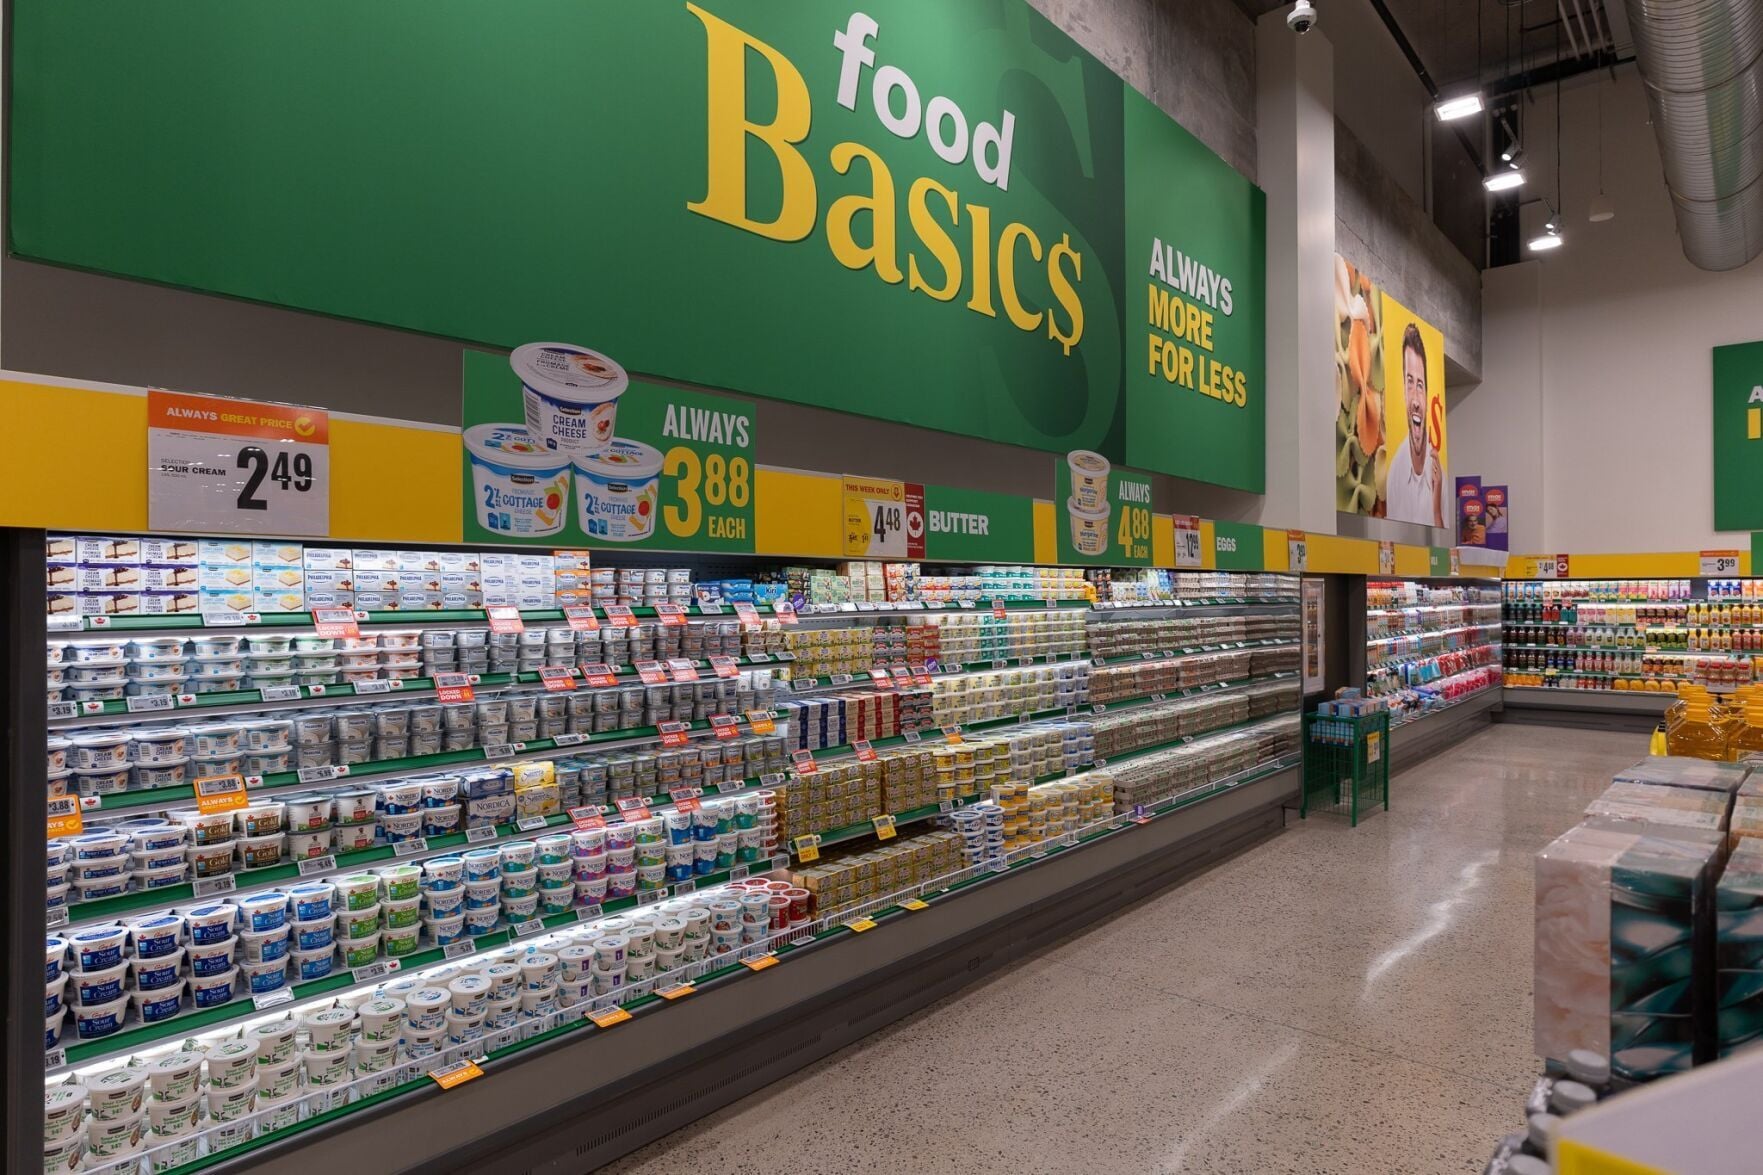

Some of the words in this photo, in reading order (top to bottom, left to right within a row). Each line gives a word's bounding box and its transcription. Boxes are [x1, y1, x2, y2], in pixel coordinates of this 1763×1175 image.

[833, 12, 1015, 190] food
[1149, 237, 1233, 316] ALWAYS
[1148, 284, 1214, 352] MORE
[1148, 333, 1194, 391] FOR
[1199, 352, 1247, 408] LESS
[167, 407, 217, 421] ALWAYS
[220, 413, 257, 426] GREAT
[260, 418, 293, 430] PRICE
[553, 414, 586, 428] CREAM
[662, 403, 750, 448] ALWAYS
[552, 425, 587, 438] CHEESE
[161, 465, 189, 475] SOUR
[192, 467, 227, 477] CREAM
[846, 484, 859, 492] THIS
[860, 484, 875, 494] WEEK
[876, 486, 890, 495] ONLY
[1118, 480, 1150, 503] ALWAYS
[502, 494, 544, 508] COTTAGE
[600, 502, 636, 515] COTTAGE
[707, 516, 747, 539] EACH
[929, 510, 989, 535] BUTTER
[1216, 536, 1237, 552] EGGS
[1134, 545, 1149, 559] EACH
[201, 796, 233, 807] ALWAYS
[476, 799, 511, 811] NORDICA
[258, 819, 278, 827] Gold
[208, 826, 228, 835] Gold
[256, 848, 276, 857] Gold
[209, 858, 229, 866] Gold
[472, 888, 496, 896] NORDICA
[434, 896, 460, 905] NORDICA
[203, 930, 226, 939] Cream
[99, 949, 115, 957] Sour
[150, 943, 173, 952] Cream
[94, 954, 118, 964] Cream
[204, 962, 227, 971] Cream
[150, 974, 173, 984] Cream
[97, 983, 115, 991] Sour
[94, 988, 117, 998] Cream
[206, 992, 228, 1001] Cream
[155, 1005, 177, 1015] Cream
[88, 1022, 113, 1032] Cream
